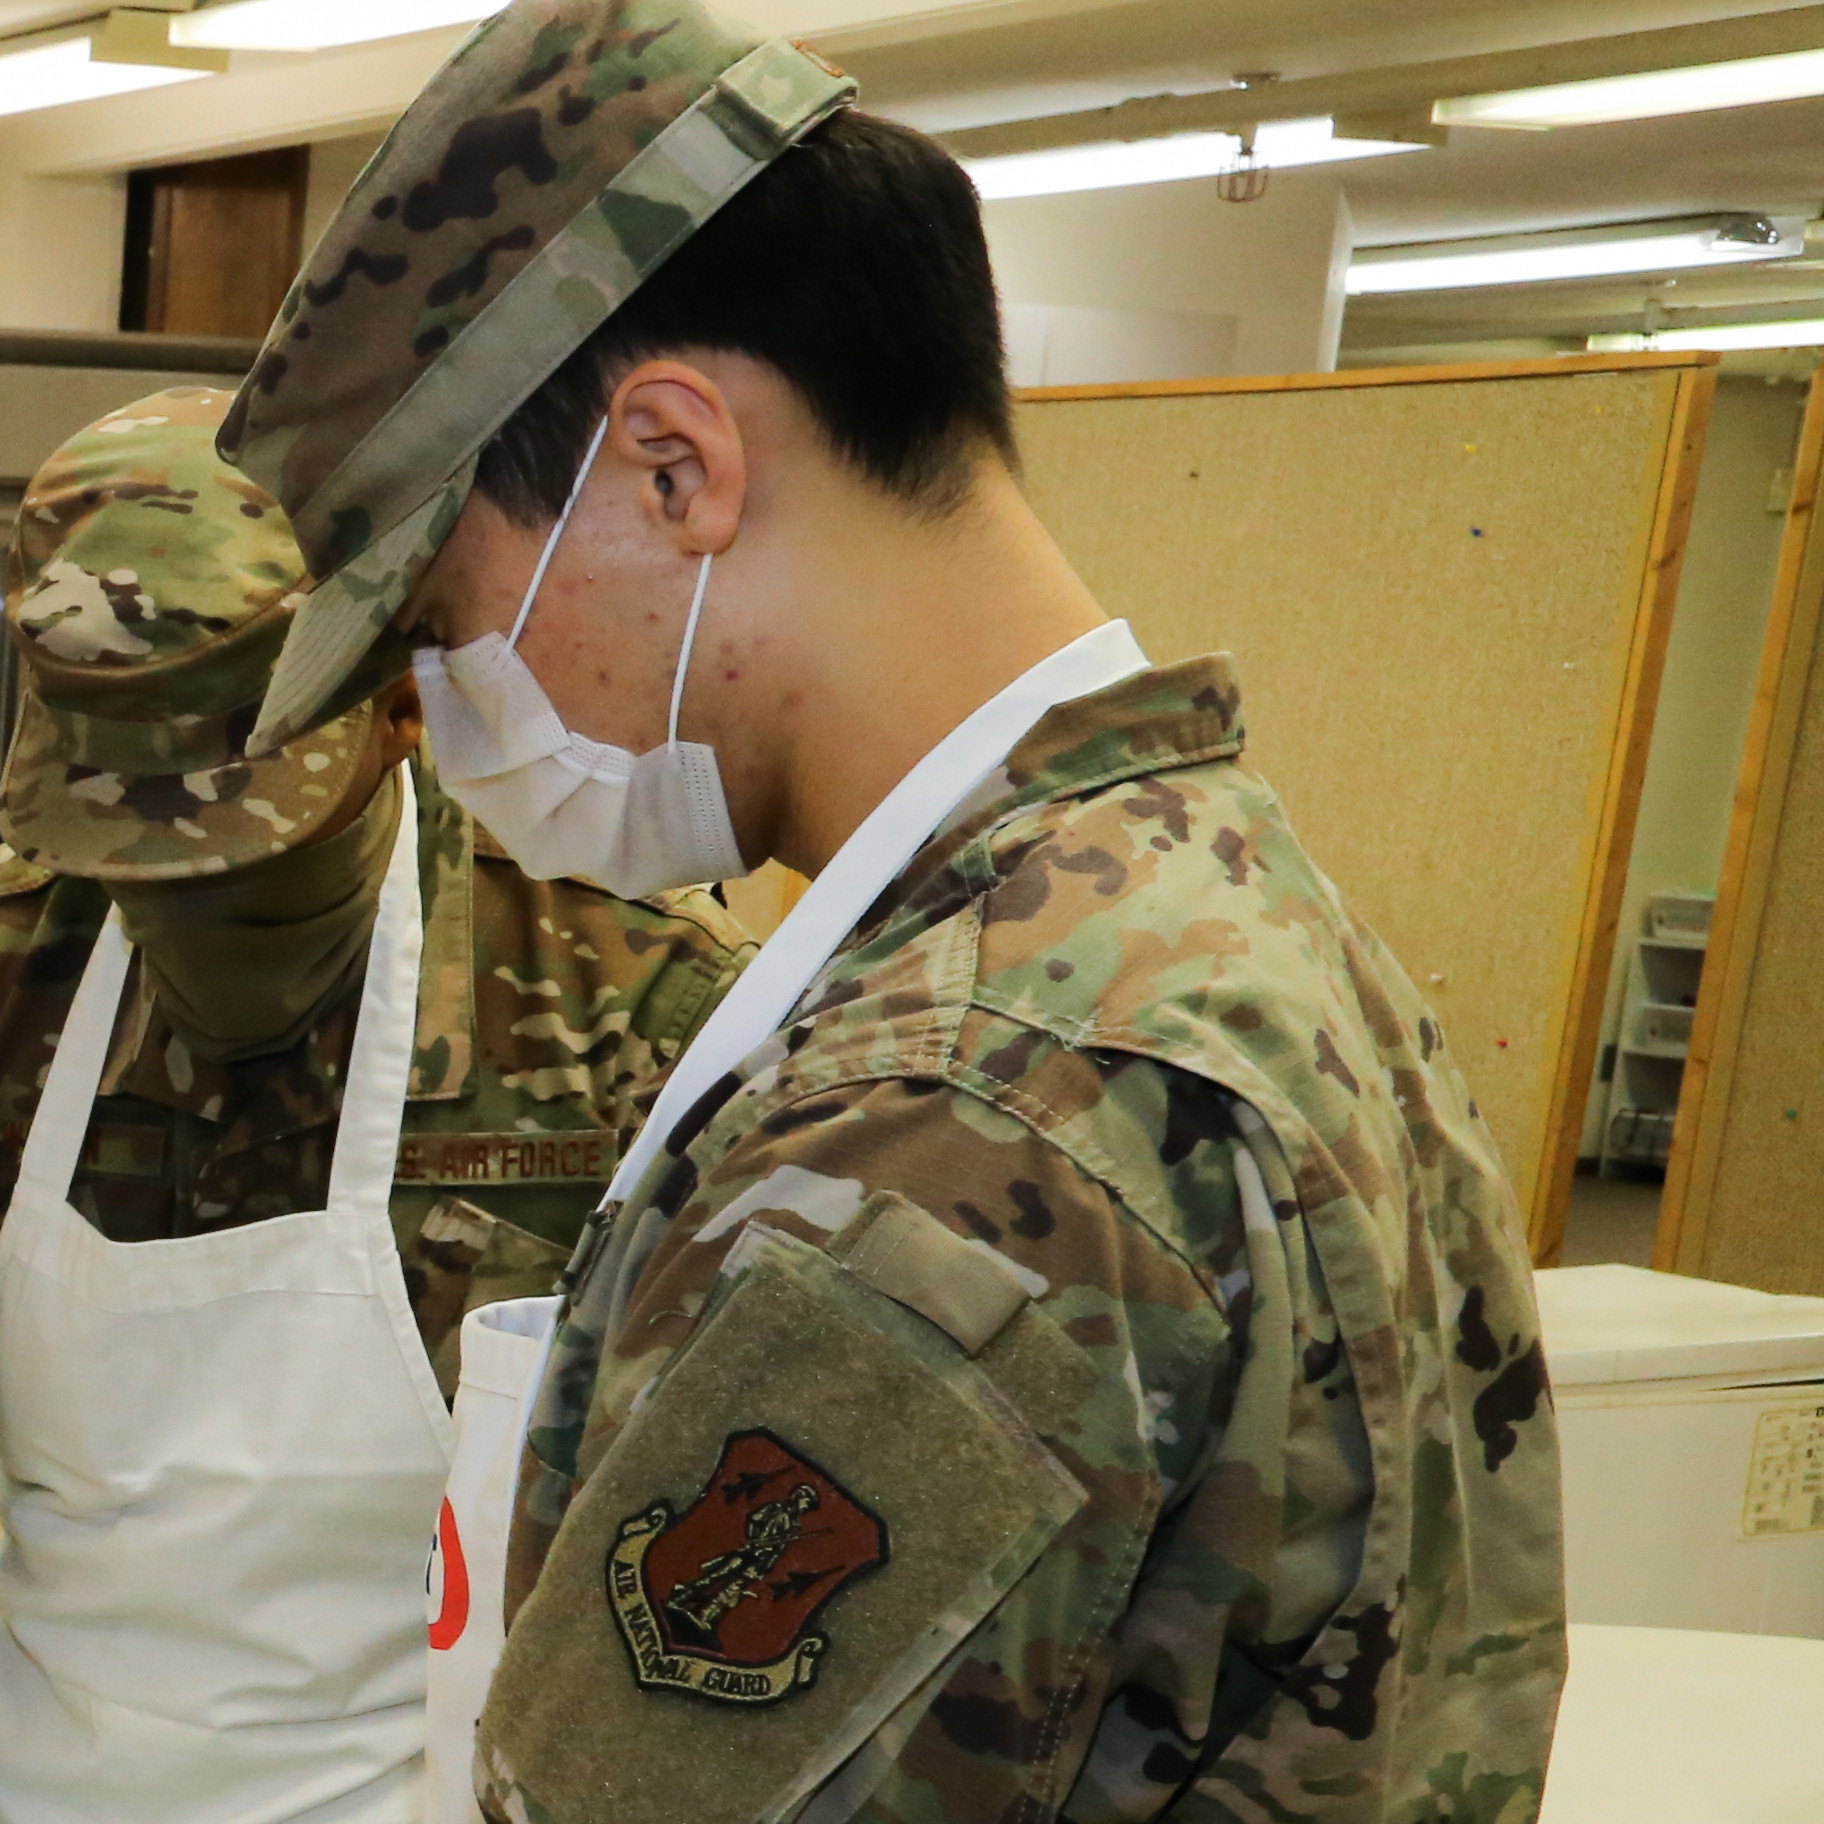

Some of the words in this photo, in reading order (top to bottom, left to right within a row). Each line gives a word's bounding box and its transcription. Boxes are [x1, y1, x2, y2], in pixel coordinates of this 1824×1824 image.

[439, 1140, 490, 1180] AIR
[500, 1139, 603, 1180] FORCE
[612, 1559, 640, 1600] AIR
[623, 1603, 692, 1684] NATIONAL
[702, 1668, 773, 1697] GUARD
